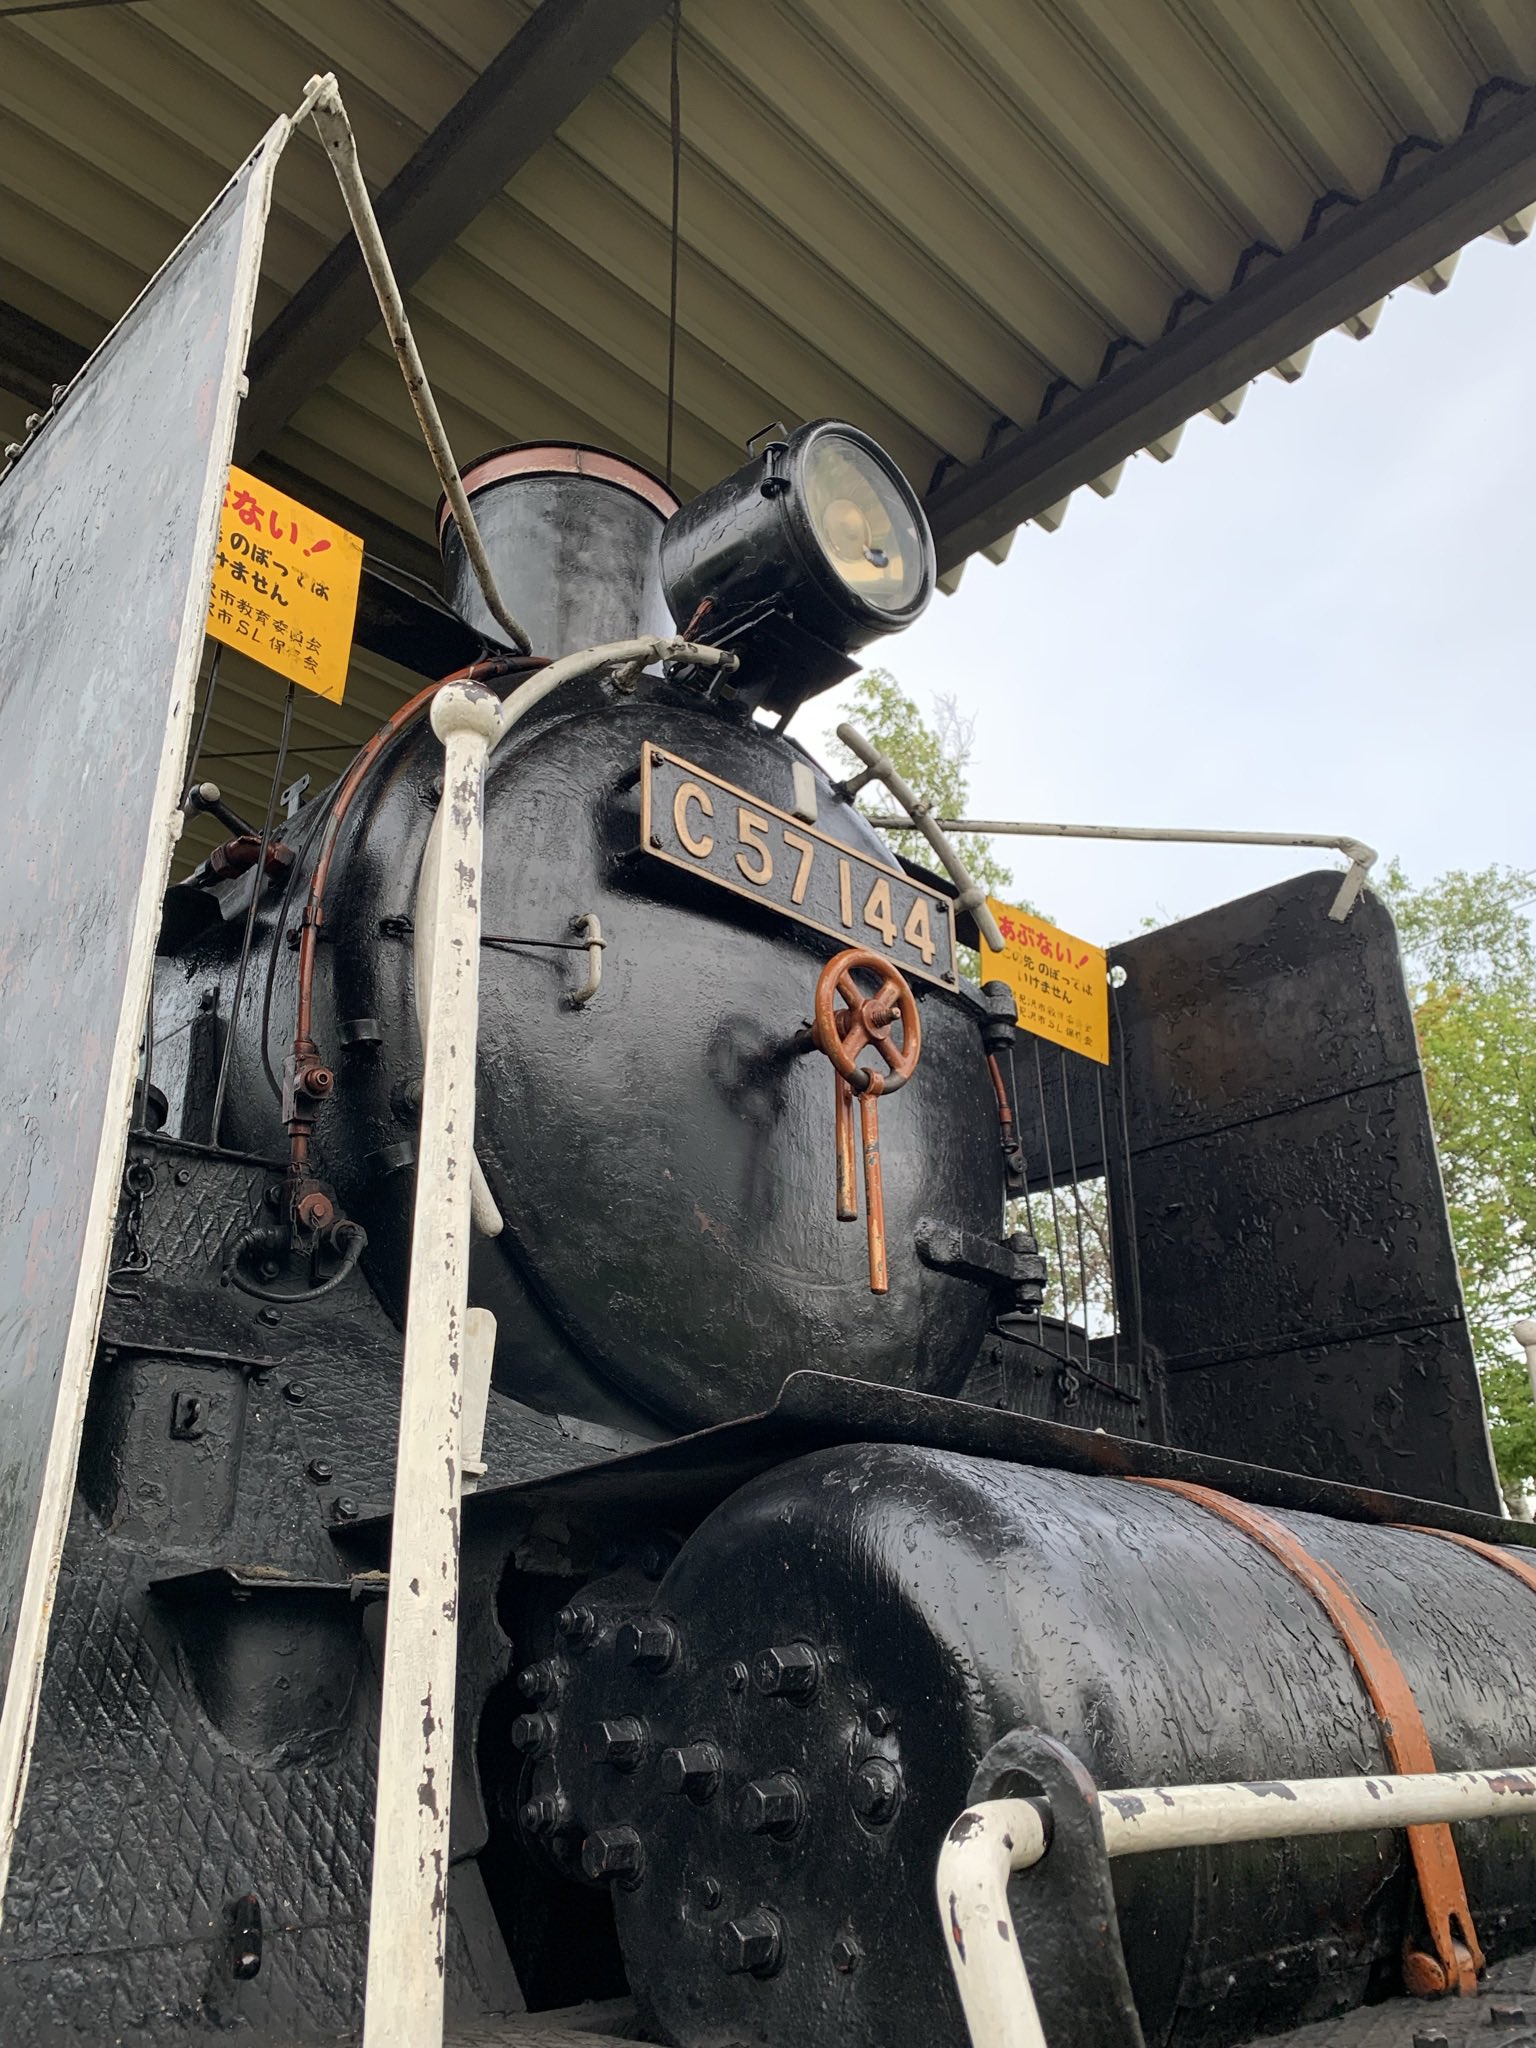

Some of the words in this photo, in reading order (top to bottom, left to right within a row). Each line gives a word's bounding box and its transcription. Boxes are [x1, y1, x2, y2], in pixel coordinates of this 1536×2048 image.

[222, 481, 332, 558] ない!
[1017, 971, 1073, 1005] いけません
